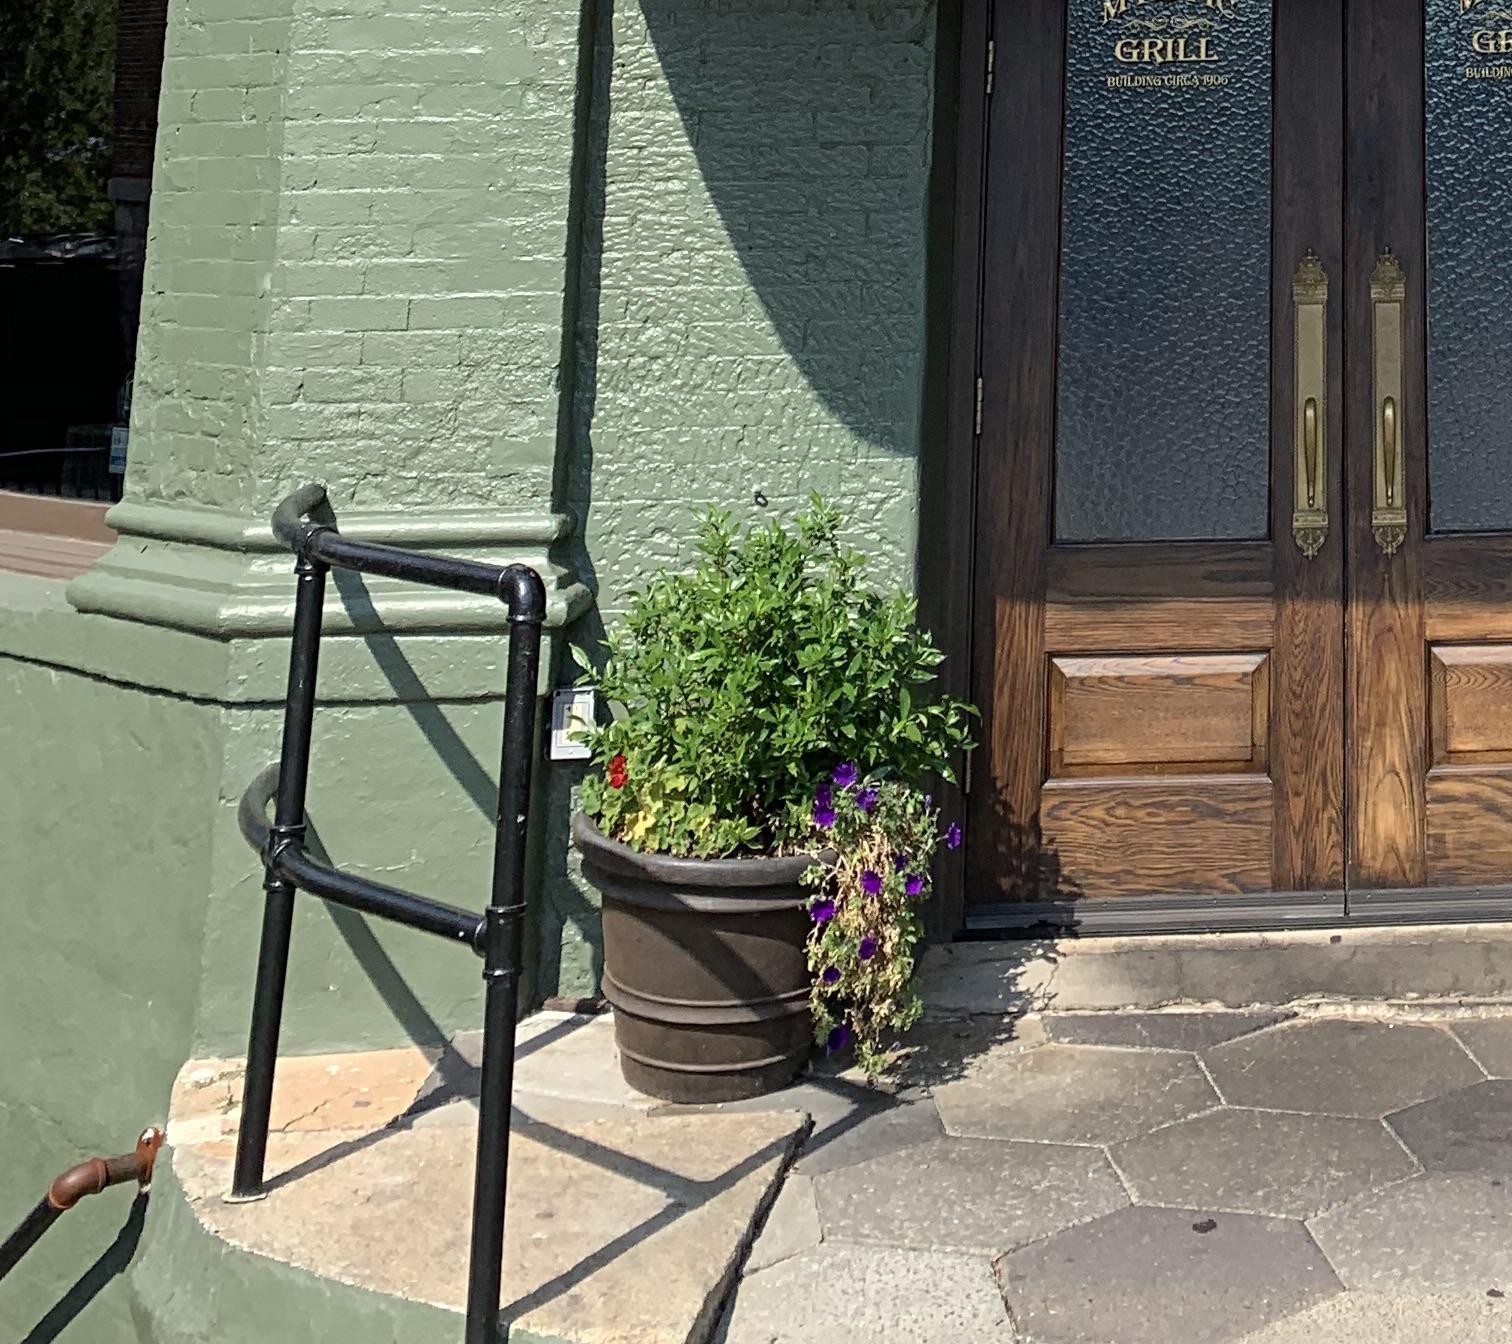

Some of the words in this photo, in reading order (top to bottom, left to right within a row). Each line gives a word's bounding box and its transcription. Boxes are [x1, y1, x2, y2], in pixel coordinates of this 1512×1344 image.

[1114, 37, 1219, 65] GRILL
[1107, 75, 1162, 87] BUILDING
[1164, 75, 1199, 87] CIRCA
[1202, 74, 1229, 86] 1906
